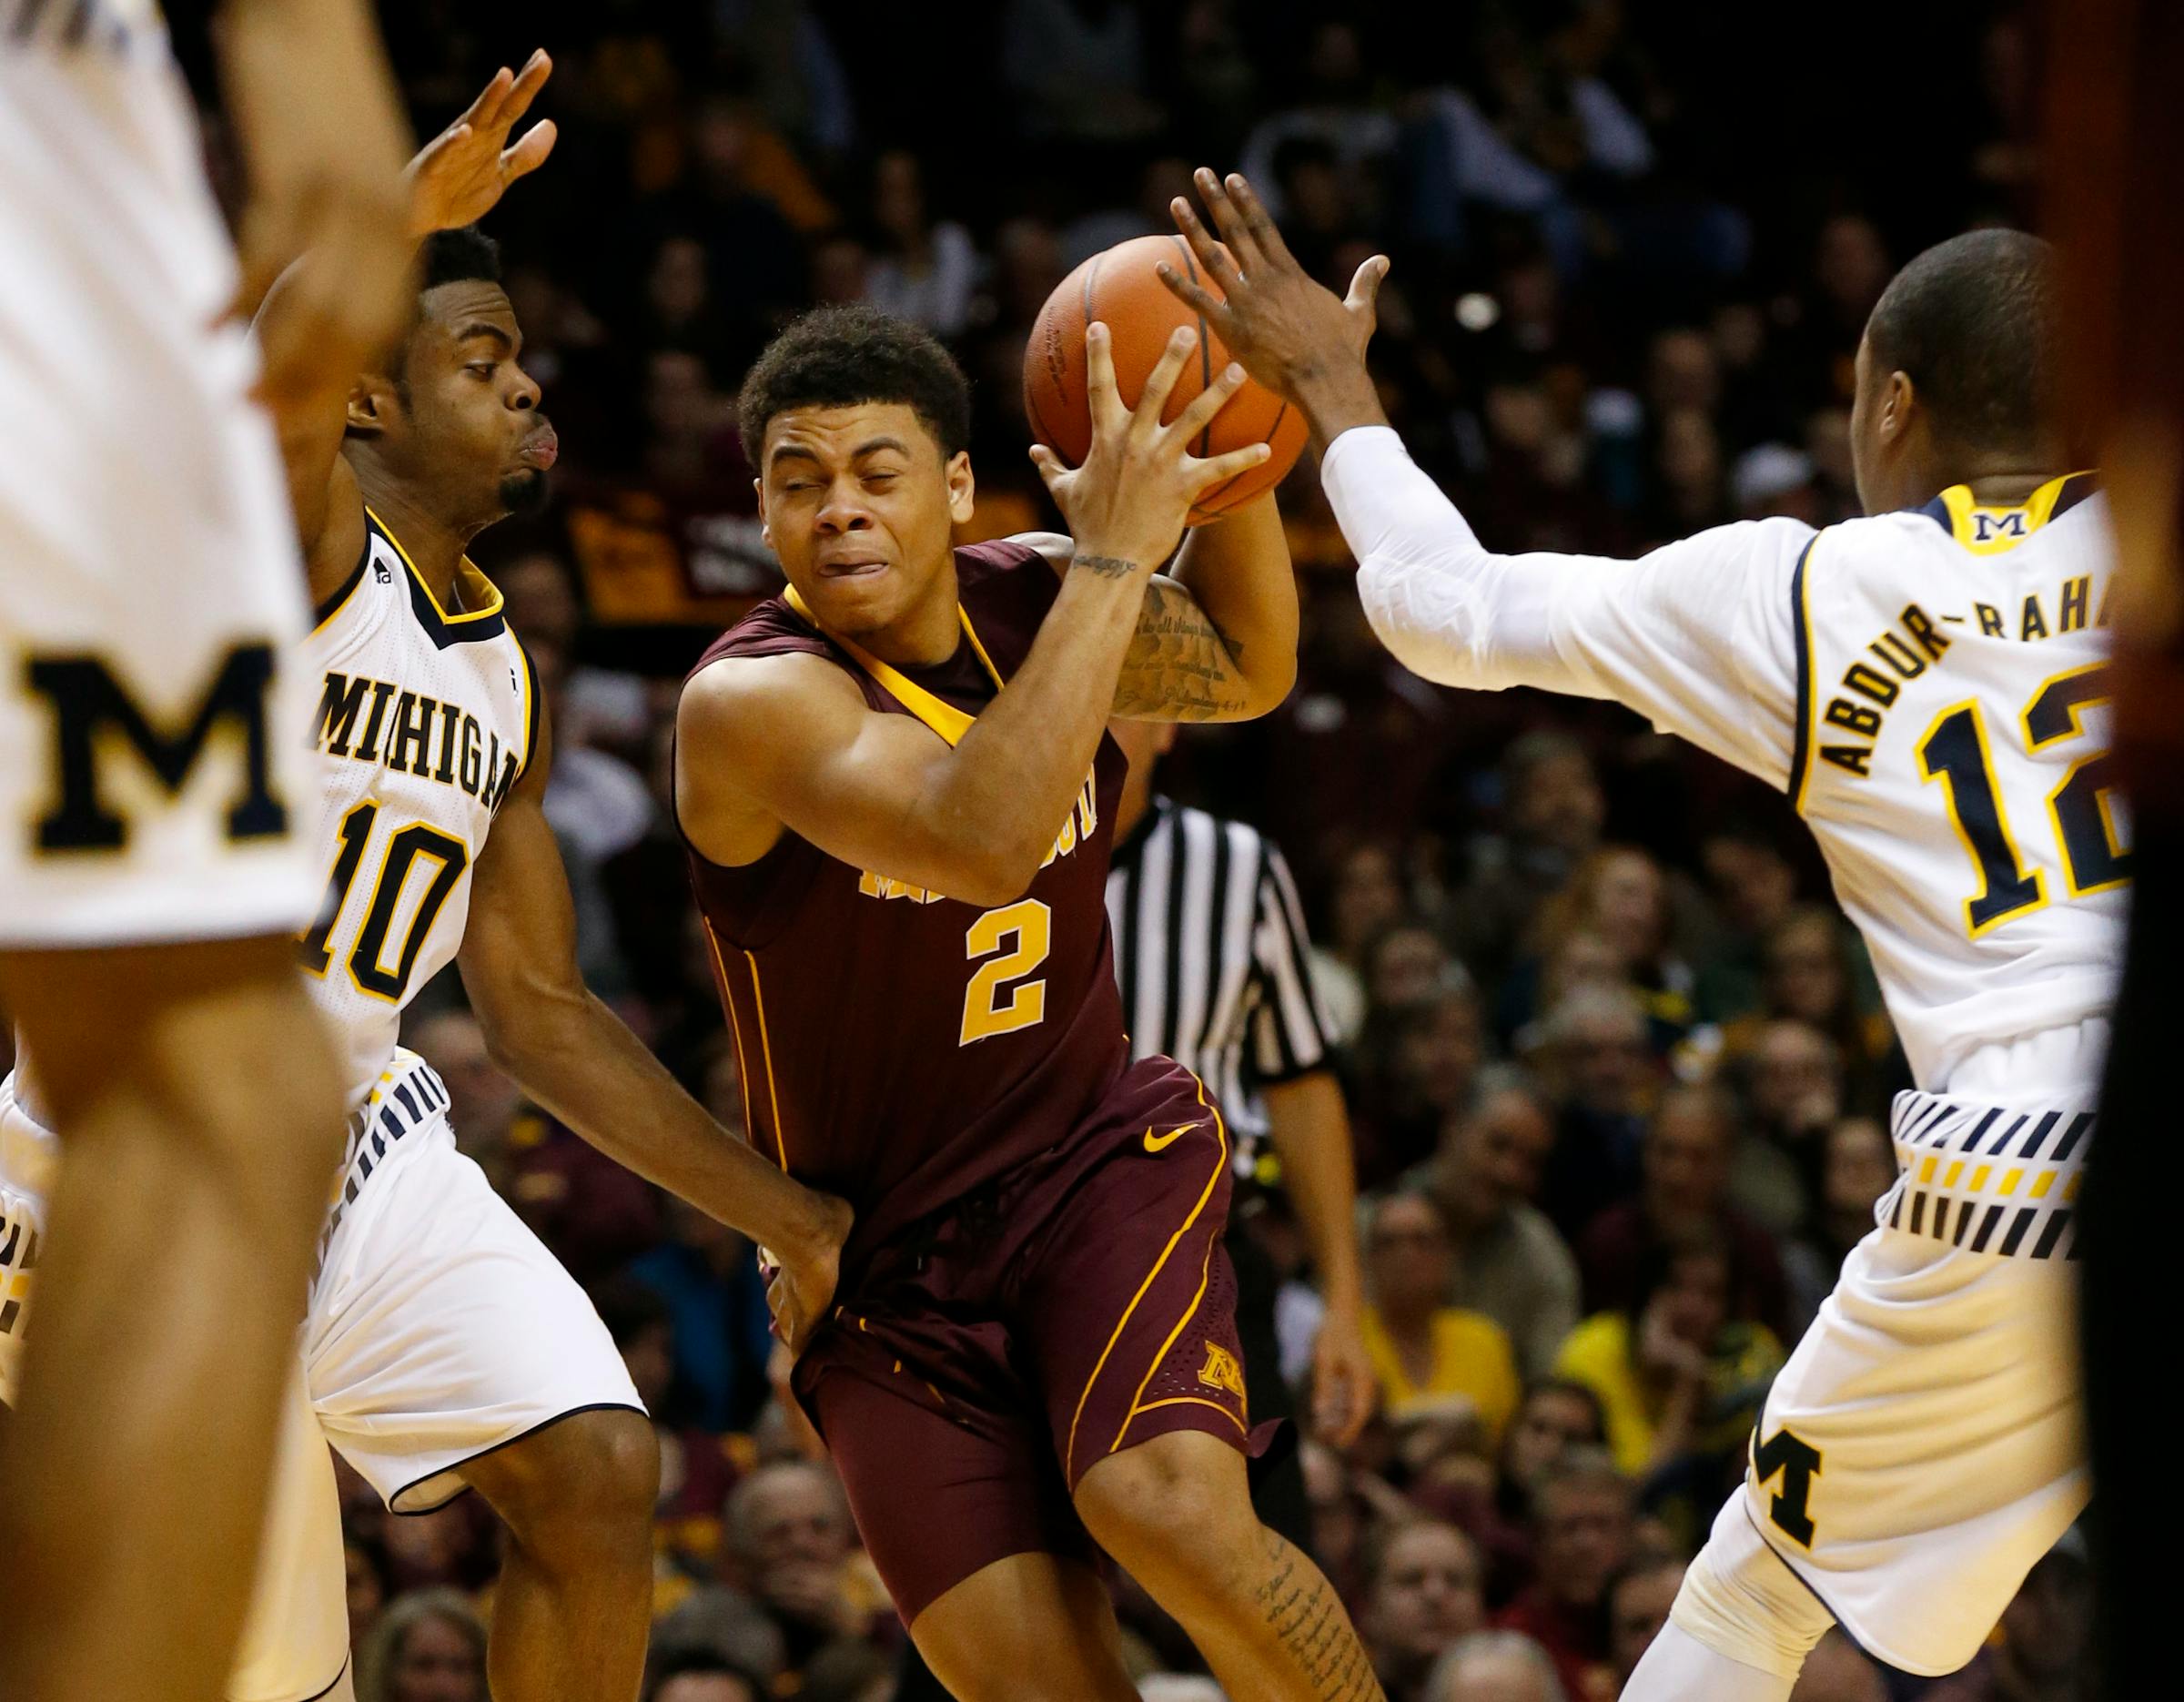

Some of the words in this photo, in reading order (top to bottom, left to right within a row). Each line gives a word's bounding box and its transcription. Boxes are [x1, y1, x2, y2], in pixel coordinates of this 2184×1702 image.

[1971, 511, 2027, 542] M
[25, 641, 288, 850] M
[1819, 573, 2114, 779] ABDUR-RAH
[298, 797, 470, 1005] 10
[1915, 660, 2132, 939] 12
[959, 897, 1051, 1047] 2
